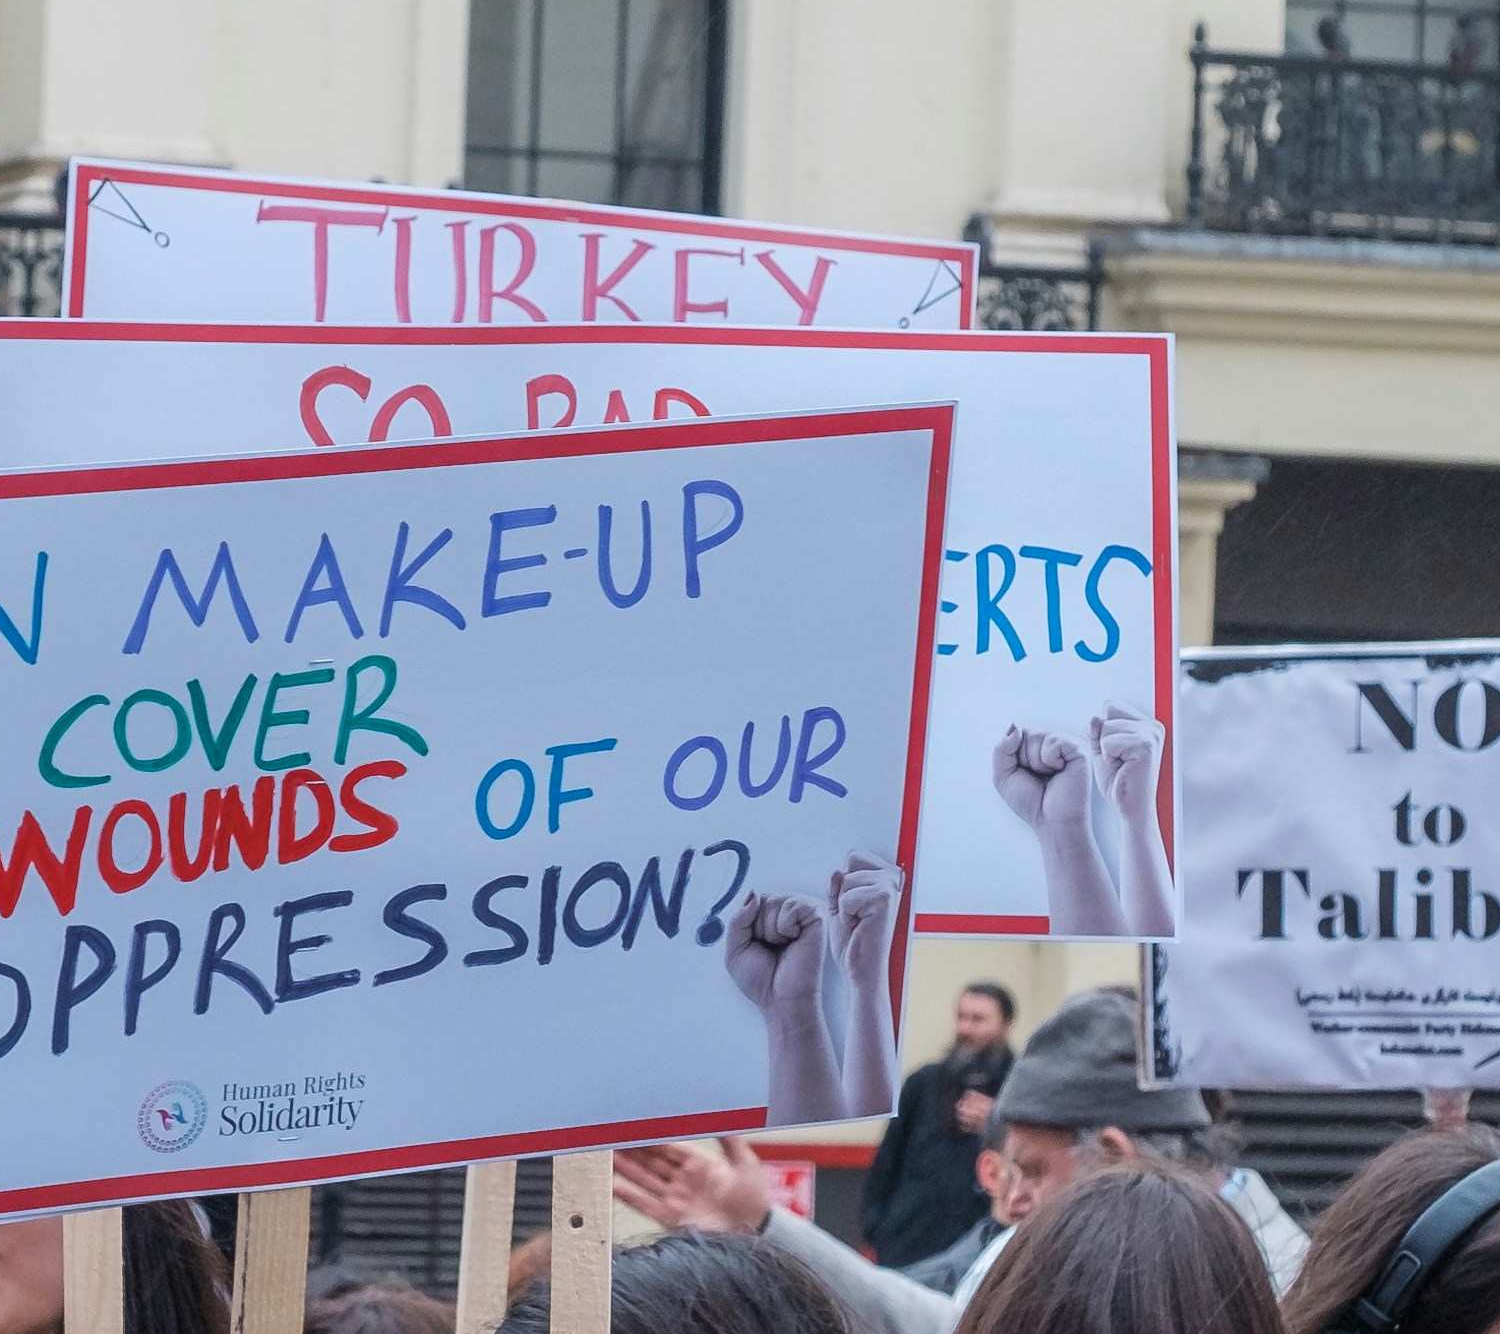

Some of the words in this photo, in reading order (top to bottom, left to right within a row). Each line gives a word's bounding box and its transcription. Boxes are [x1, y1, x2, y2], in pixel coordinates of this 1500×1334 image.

[122, 480, 745, 655] MAKE-UP
[37, 654, 430, 790] COVER
[474, 738, 619, 841] OF
[663, 707, 849, 812] OUR
[1391, 790, 1468, 848] to
[219, 1095, 366, 1137] Solidarity
[222, 1082, 297, 1102] Human
[304, 1071, 367, 1097] Rights
